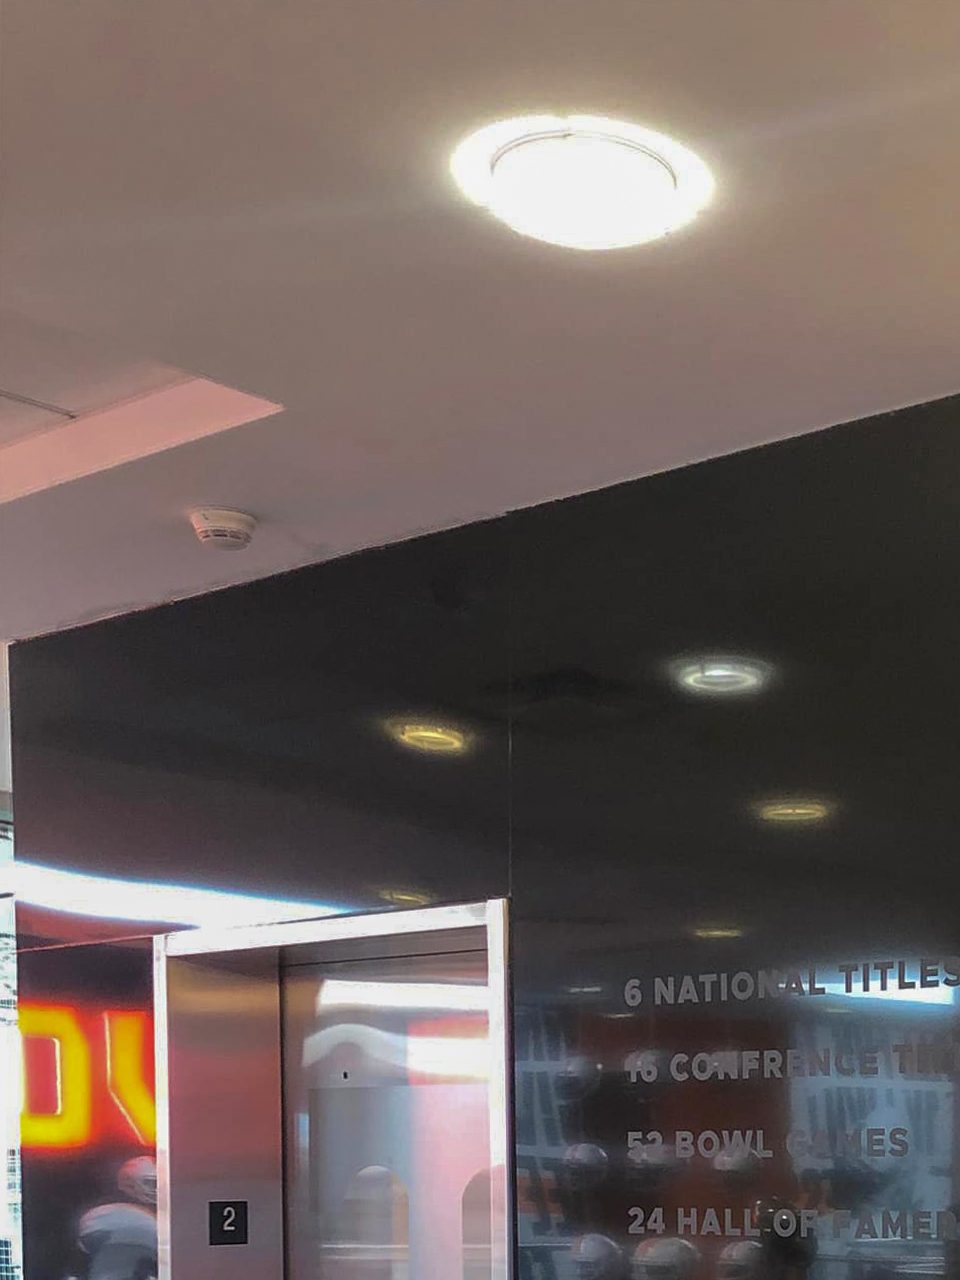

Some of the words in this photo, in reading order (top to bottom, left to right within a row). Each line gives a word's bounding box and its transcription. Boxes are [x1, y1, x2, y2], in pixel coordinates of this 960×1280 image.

[623, 978, 643, 1007] 6
[654, 963, 826, 1005] NATIONAL
[627, 1131, 663, 1160] 52
[675, 1129, 774, 1159] BOWL
[786, 1127, 910, 1158] GAMES
[222, 1206, 236, 1232] 2
[627, 1207, 666, 1235] 24
[678, 1206, 761, 1237] HALL
[773, 1208, 816, 1239] OF
